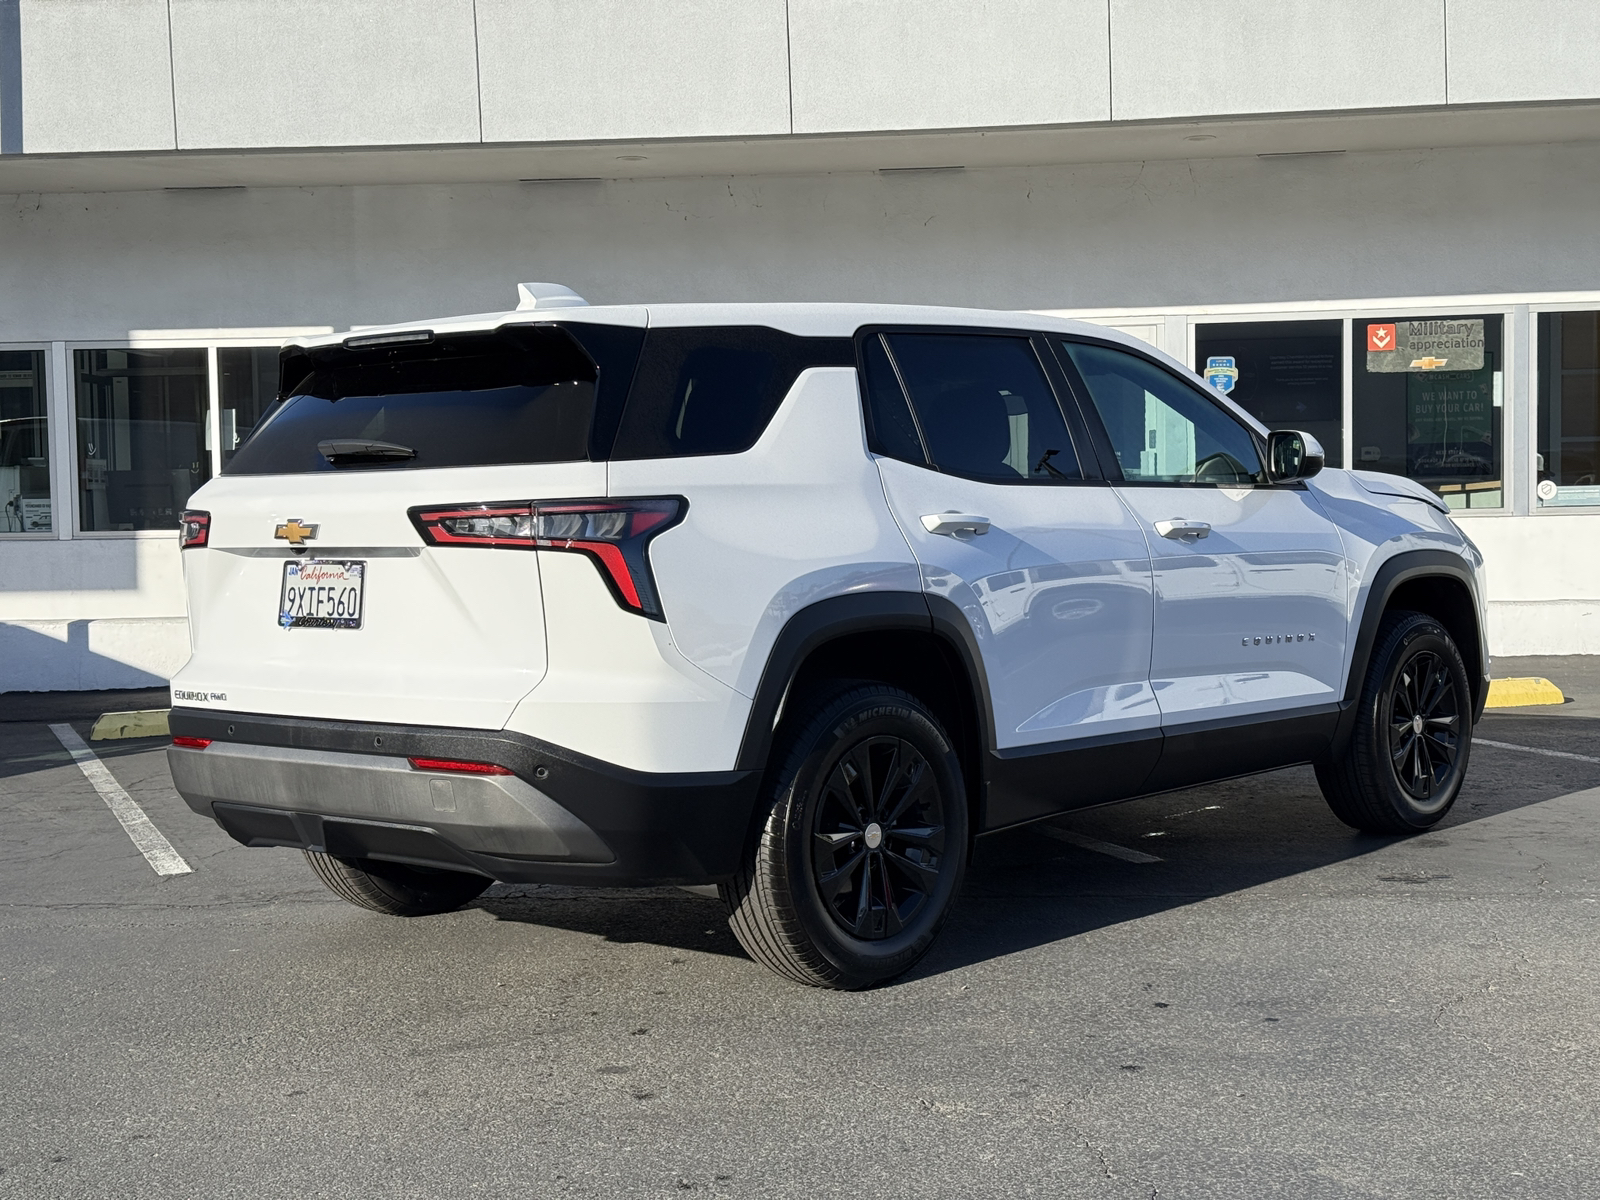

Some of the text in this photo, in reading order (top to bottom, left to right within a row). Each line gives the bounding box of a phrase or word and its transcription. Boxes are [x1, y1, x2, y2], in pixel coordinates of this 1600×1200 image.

[1409, 322, 1475, 337] Military
[1409, 338, 1484, 351] appreciation
[1422, 391, 1478, 401] WE WANT TO
[1415, 403, 1484, 414] BUY YOUR CAR!
[300, 566, 350, 585] California
[288, 587, 357, 617] 9XIF560
[1242, 633, 1316, 646] EQUINOX
[174, 690, 210, 702] EQUINOX
[858, 706, 909, 722] MICHELIN
